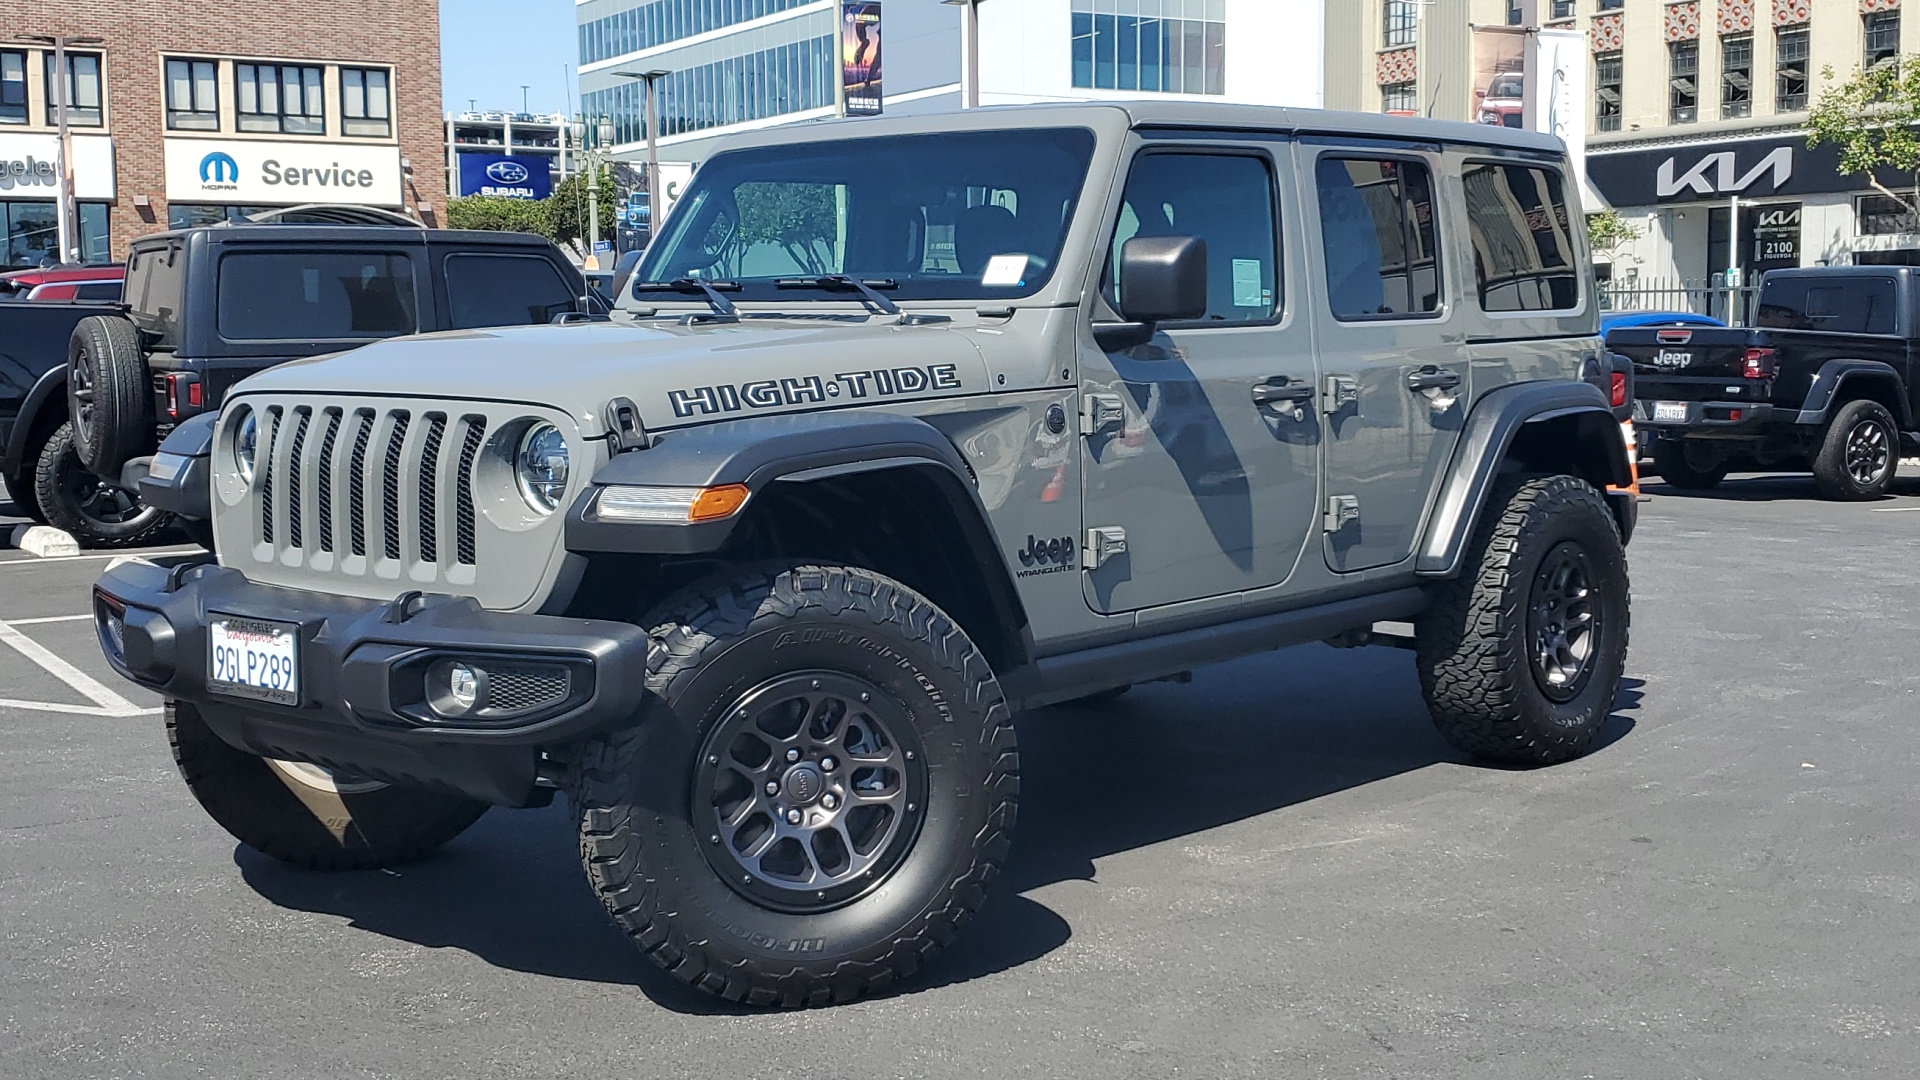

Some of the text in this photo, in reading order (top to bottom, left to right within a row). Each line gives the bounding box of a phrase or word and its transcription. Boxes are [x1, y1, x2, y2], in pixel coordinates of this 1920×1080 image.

[262, 159, 373, 188] Service
[481, 186, 533, 197] SUBARU
[1766, 241, 1793, 253] 2100
[1653, 349, 1692, 368] Jeep
[668, 363, 961, 417] HIGH TIDE
[1018, 534, 1075, 567] Jeep
[1016, 565, 1067, 579] WRANGLER
[240, 620, 273, 633] ANGELES
[216, 644, 292, 690] 9GLP289
